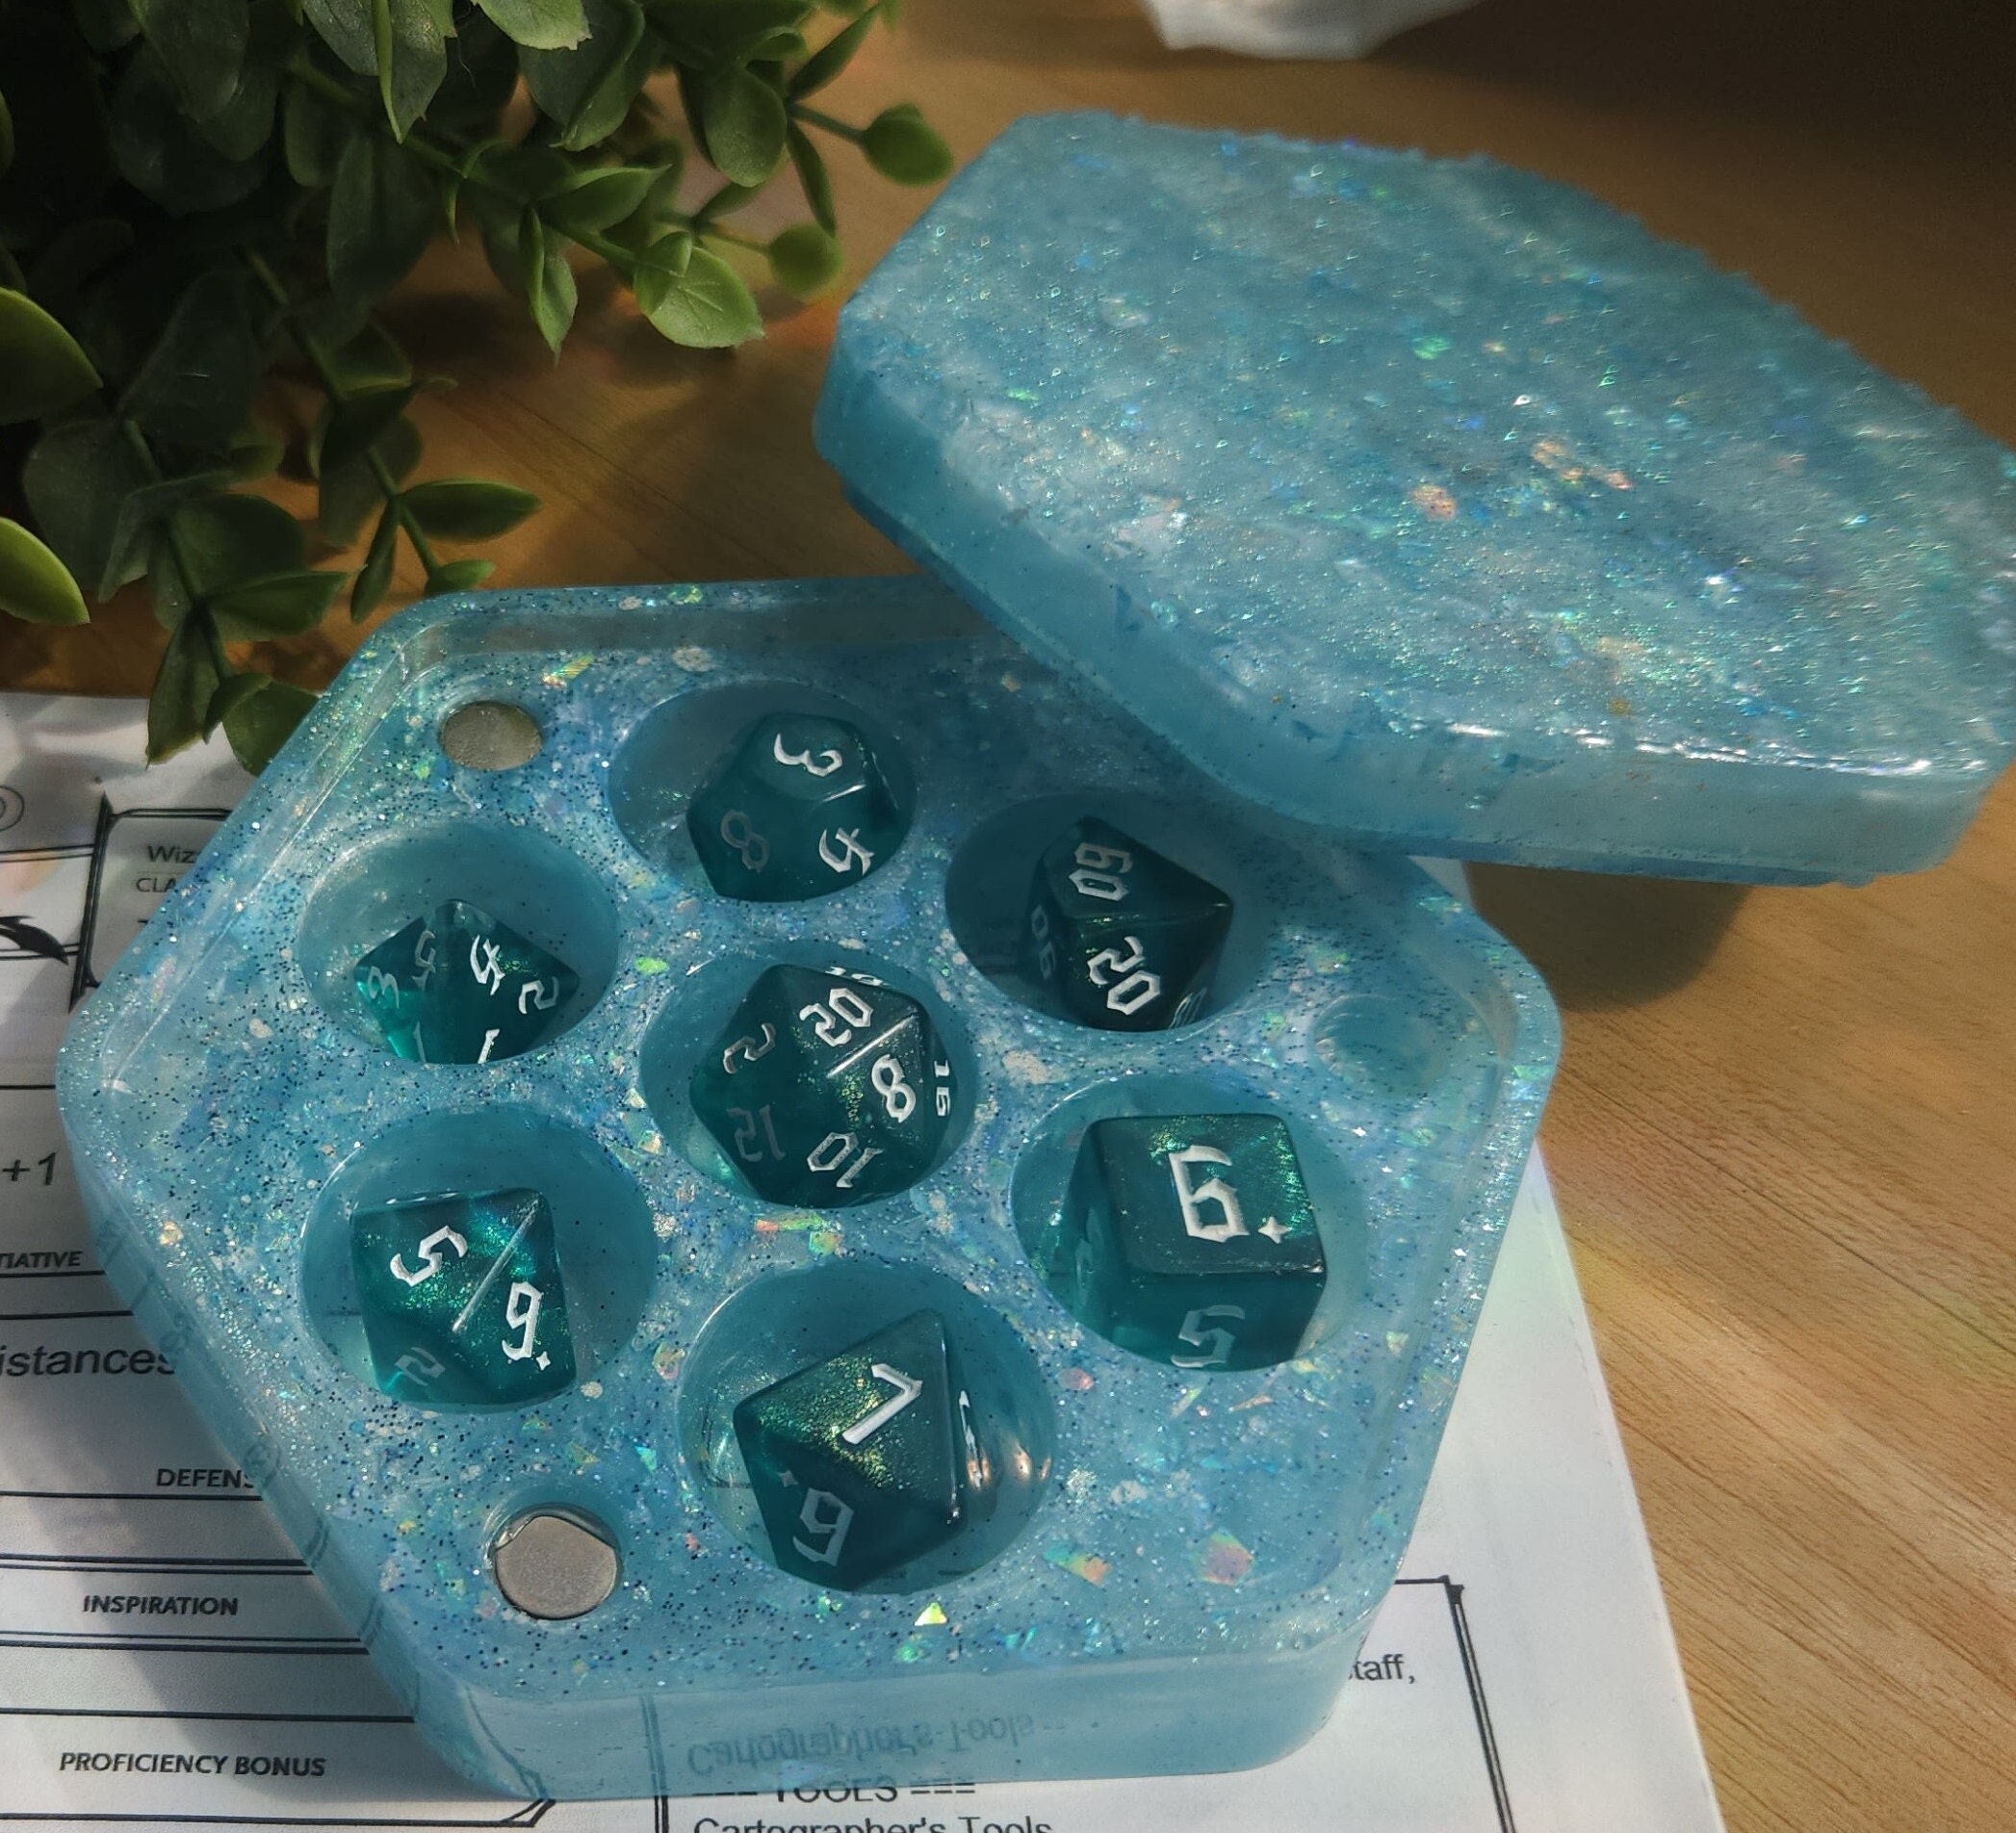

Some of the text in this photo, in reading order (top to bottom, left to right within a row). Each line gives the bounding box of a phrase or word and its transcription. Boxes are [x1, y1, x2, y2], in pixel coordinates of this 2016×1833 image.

[773, 733, 842, 777] 3
[147, 846, 202, 864] Wiz
[721, 809, 769, 873] 8
[819, 828, 874, 876] 4
[470, 935, 505, 996] 4
[1087, 936, 1160, 1016] 20
[518, 976, 559, 1014] 2
[799, 988, 873, 1046] 20
[723, 1023, 776, 1074] 2
[871, 1054, 916, 1123] 8
[2, 1152, 57, 1185] +1
[807, 1132, 885, 1188] 10
[1169, 1145, 1251, 1243] 6
[390, 1225, 468, 1287] 5
[1171, 1304, 1246, 1369] 5
[841, 1363, 923, 1445] 7
[83, 1594, 238, 1616] INSPIRATION
[1349, 1654, 1416, 1684] taff,
[59, 1752, 326, 1776] PROFICIENCY BONUS
